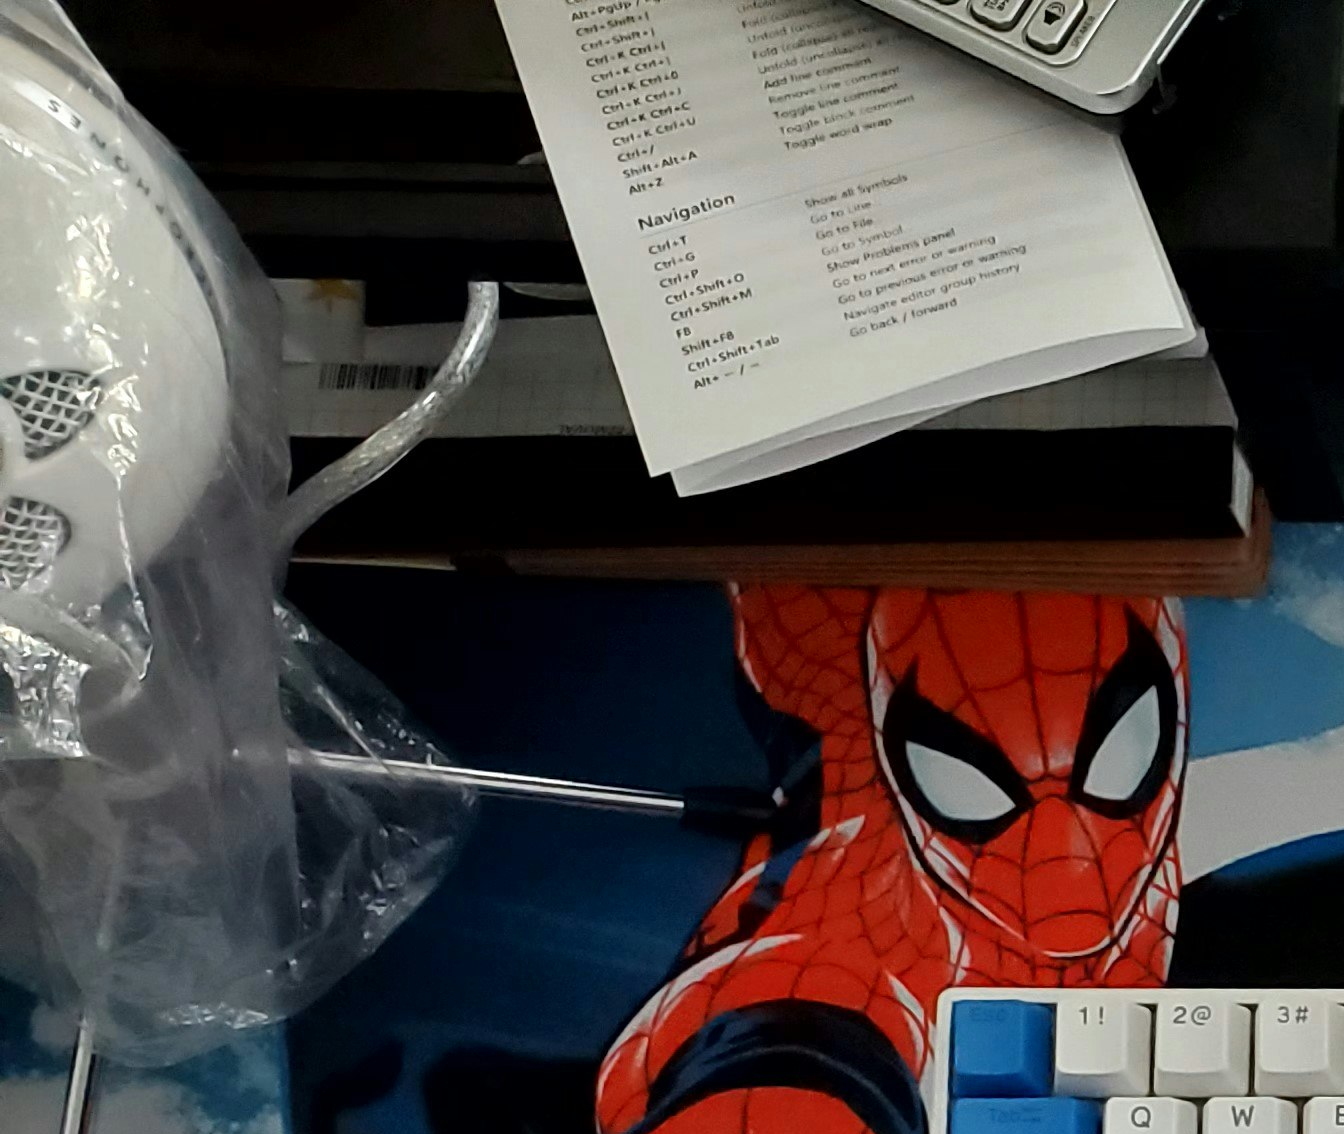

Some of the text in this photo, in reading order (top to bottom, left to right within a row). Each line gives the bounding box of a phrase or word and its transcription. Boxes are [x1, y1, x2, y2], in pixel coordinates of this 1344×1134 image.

[637, 195, 734, 229] Navigation
[804, 194, 837, 207] Show
[835, 225, 849, 233] to
[841, 242, 855, 250] to
[826, 227, 955, 272] Show Problems panel
[831, 235, 996, 288] Go to next error or warning
[837, 244, 1026, 304] Go to previous error or warning
[843, 263, 1019, 320] Navigate editor group history
[849, 326, 867, 337] Go
[869, 315, 898, 330] back
[910, 297, 957, 318] forward
[687, 335, 779, 372] Ctrl+Shift+Tab
[1130, 1105, 1152, 1129] Q
[1231, 1104, 1255, 1127] W
